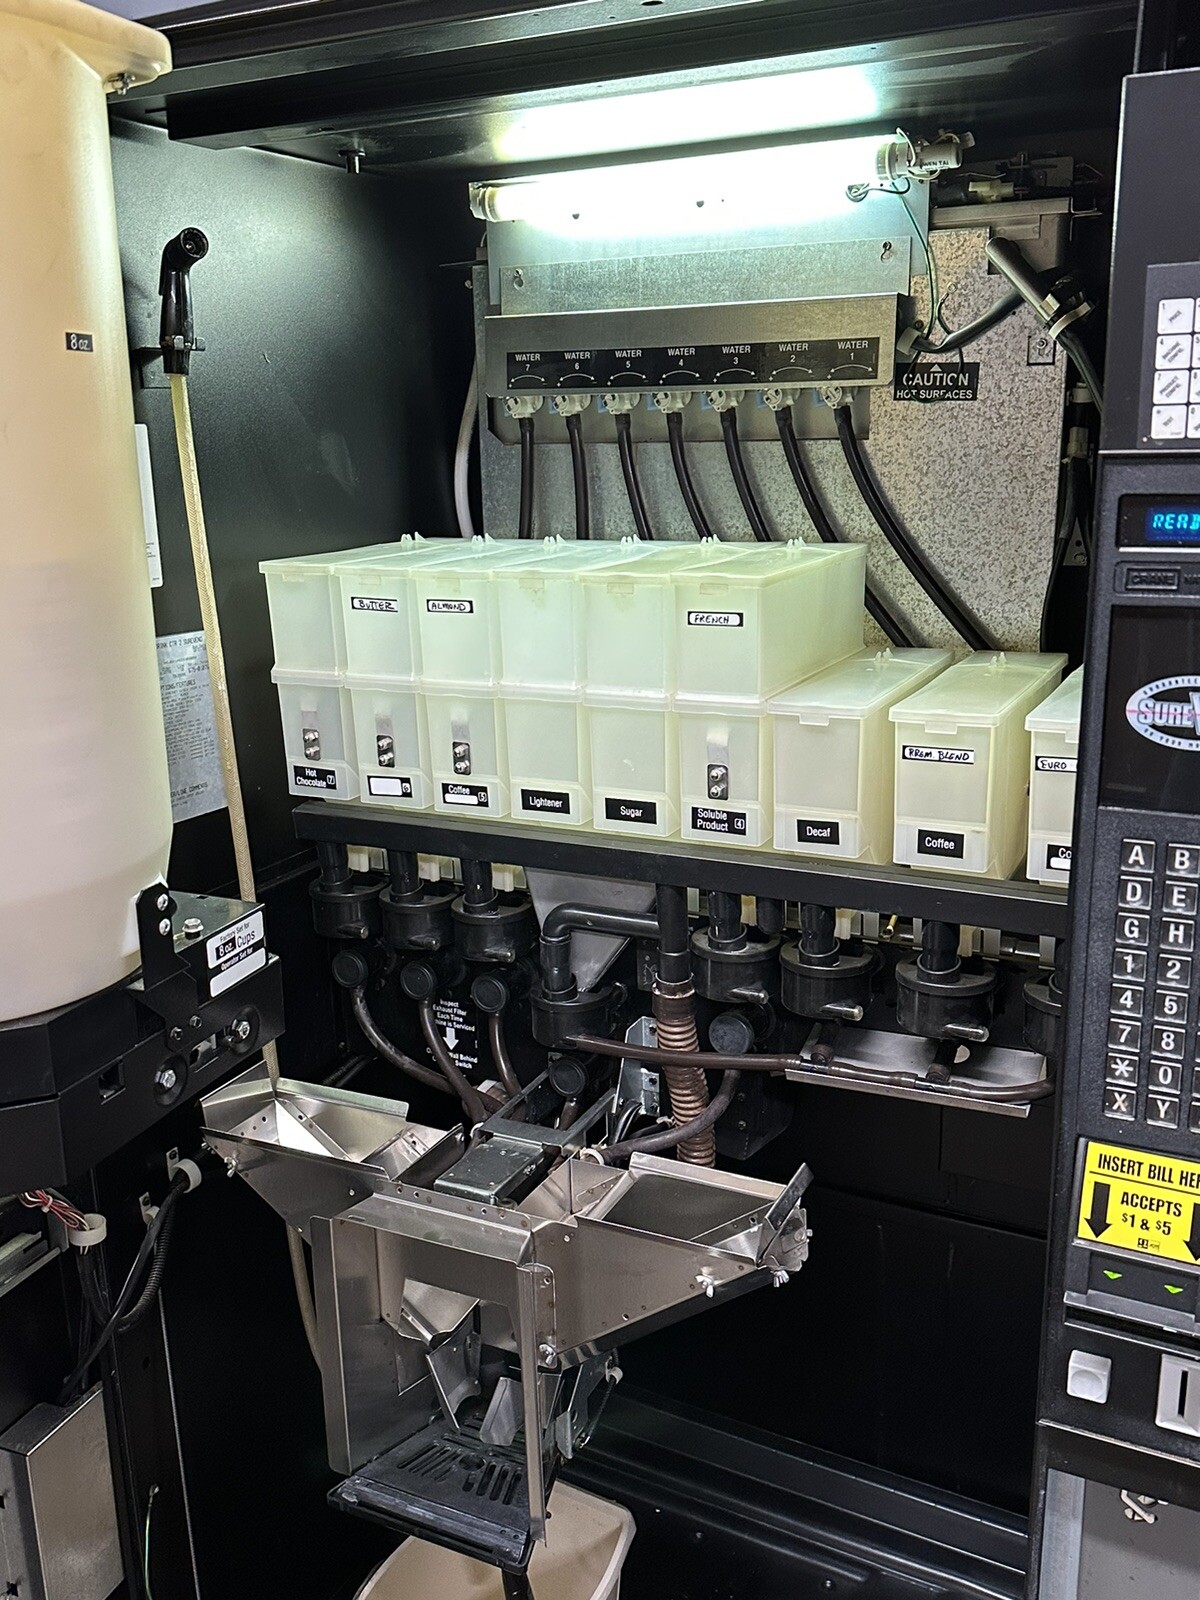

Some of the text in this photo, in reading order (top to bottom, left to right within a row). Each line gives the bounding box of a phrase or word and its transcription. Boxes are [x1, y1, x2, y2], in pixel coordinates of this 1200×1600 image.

[70, 334, 77, 349] 8
[779, 343, 809, 352] WATER
[838, 340, 869, 349] WATER
[564, 351, 591, 360] WATER
[615, 349, 642, 358] WATER
[668, 347, 696, 356] WATER
[722, 345, 751, 354] WATER
[515, 353, 541, 362] WATER
[733, 356, 739, 365] 3
[790, 354, 796, 363] 2
[850, 352, 855, 360] 1
[525, 364, 530, 372] 7
[574, 362, 580, 371] 6
[625, 360, 631, 369] 5
[678, 358, 684, 367] 4
[903, 373, 969, 386] CAUTION
[896, 389, 973, 399] HOT SURFACES
[431, 602, 466, 611] ALMOND
[694, 614, 730, 624] FRENCH
[1040, 760, 1067, 770] EURO
[305, 768, 317, 777] Hot
[296, 776, 327, 788] Chocolate
[448, 785, 470, 795] Coffee
[529, 796, 563, 808] Lightener
[620, 805, 643, 818] Sugar
[697, 809, 727, 821] Soluble
[697, 819, 729, 832] Product
[806, 826, 831, 838] Decaf
[924, 836, 955, 850] Coffee
[1128, 845, 1145, 865] A
[1174, 849, 1190, 870] B
[1126, 882, 1142, 902] D
[1172, 886, 1186, 907] E
[1124, 918, 1139, 939] G
[1168, 923, 1185, 944] H
[219, 944, 225, 957] 8
[236, 930, 256, 948] Cups
[1123, 954, 1133, 973] 1
[1166, 960, 1181, 980] 2
[1119, 990, 1134, 1009] 4
[1163, 995, 1178, 1015] 5
[1119, 1024, 1132, 1043] 7
[1161, 1031, 1175, 1051] 8
[1158, 1066, 1173, 1085] 0
[1112, 1091, 1127, 1112] X
[1156, 1100, 1171, 1119] Y
[1098, 1153, 1144, 1177] INSERT
[1148, 1164, 1174, 1184] BILL
[1120, 1191, 1183, 1217] ACCEPTS
[1122, 1213, 1172, 1236] $1 & $5
